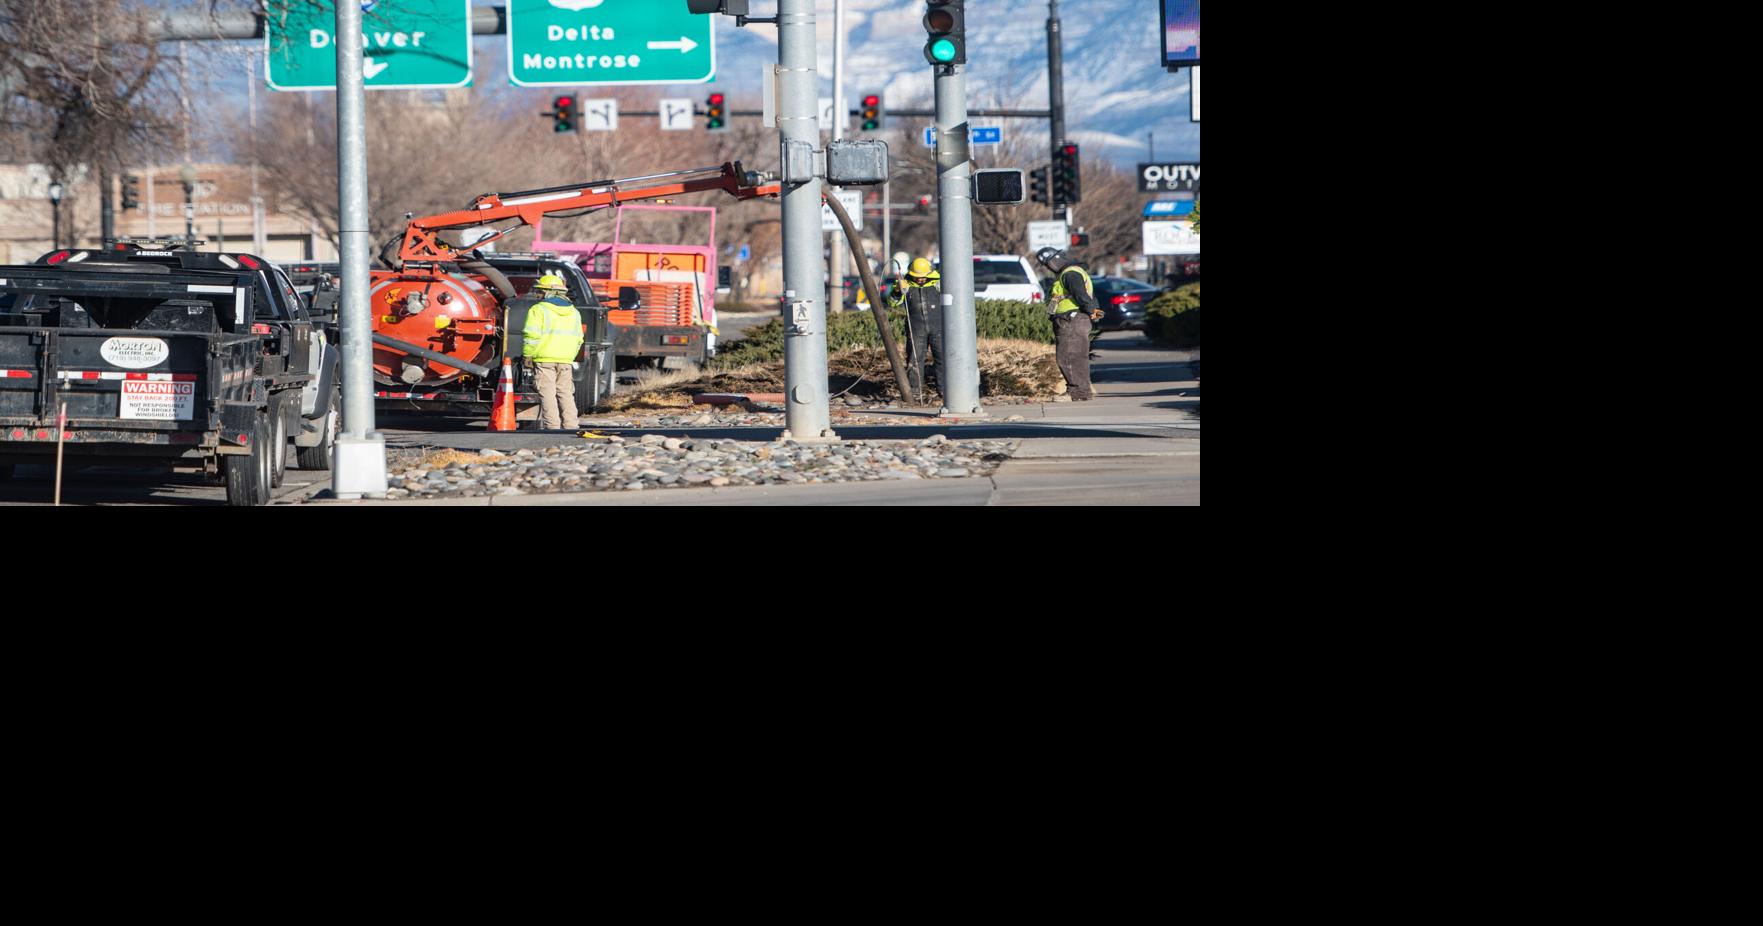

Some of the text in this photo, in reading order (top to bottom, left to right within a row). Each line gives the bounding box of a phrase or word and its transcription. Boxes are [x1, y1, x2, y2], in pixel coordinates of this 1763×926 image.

[309, 29, 425, 48] Dver
[547, 25, 615, 41] Delta
[523, 53, 641, 69] Montrose
[126, 383, 191, 394] WARNING
